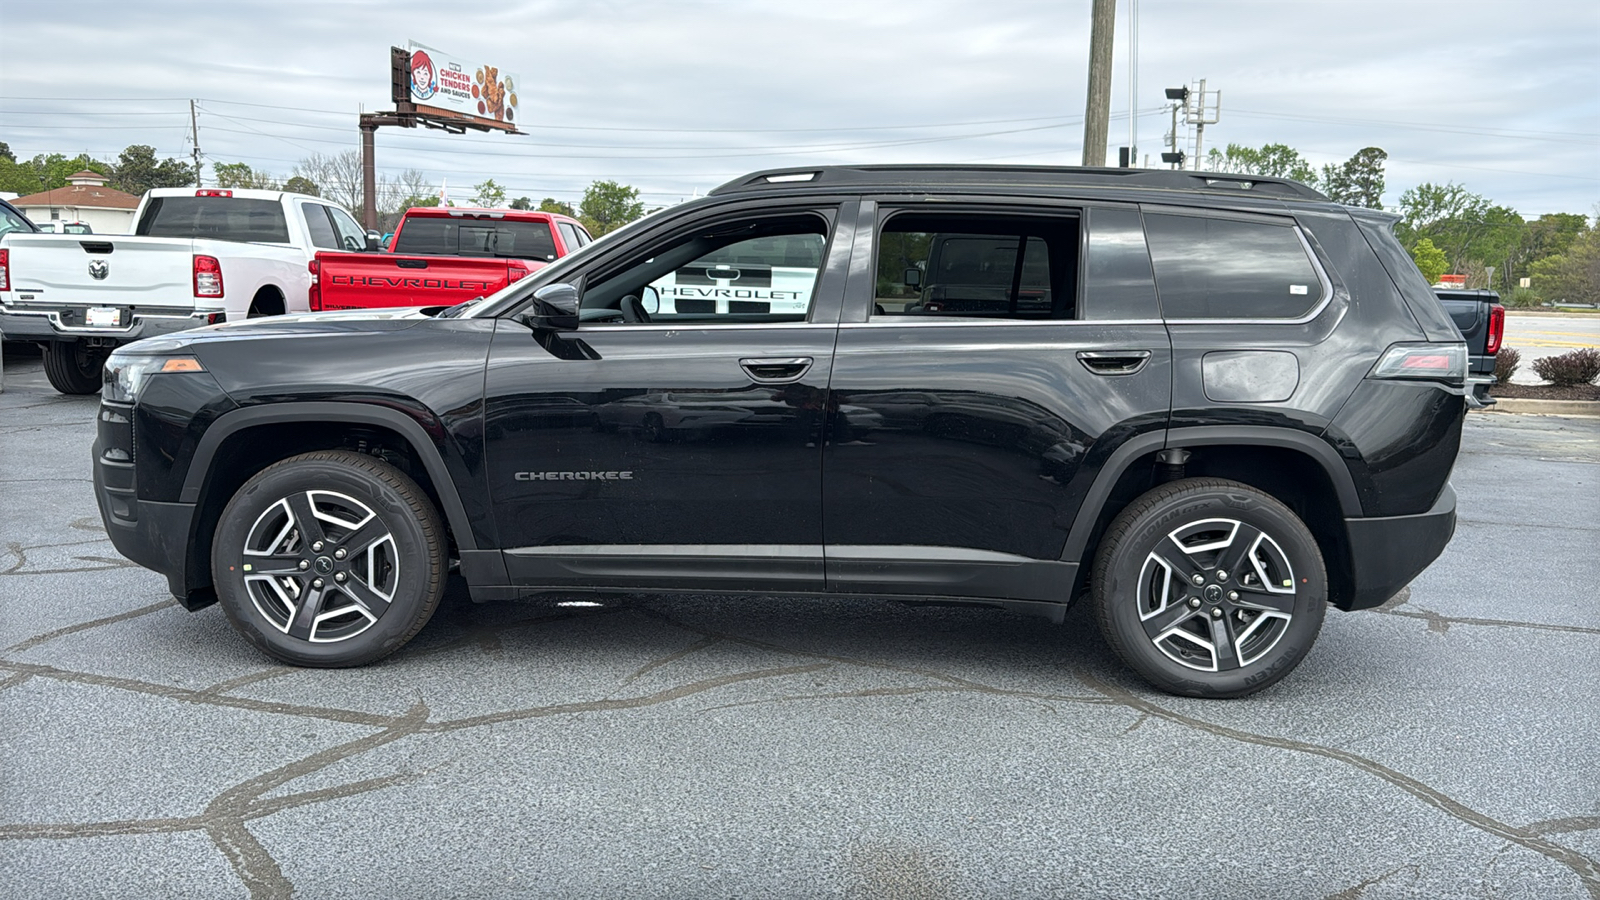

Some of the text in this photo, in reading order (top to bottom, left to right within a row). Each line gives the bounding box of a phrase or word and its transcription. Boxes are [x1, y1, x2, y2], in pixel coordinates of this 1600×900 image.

[440, 68, 470, 83] CHICKEN
[440, 77, 470, 92] TENDERS
[440, 87, 470, 99] AND SAUCES
[332, 275, 493, 290] CHEVROLET
[655, 286, 803, 300] HEVROLET
[514, 471, 634, 481] CHEROKEE
[1243, 646, 1298, 686] NEXEN
